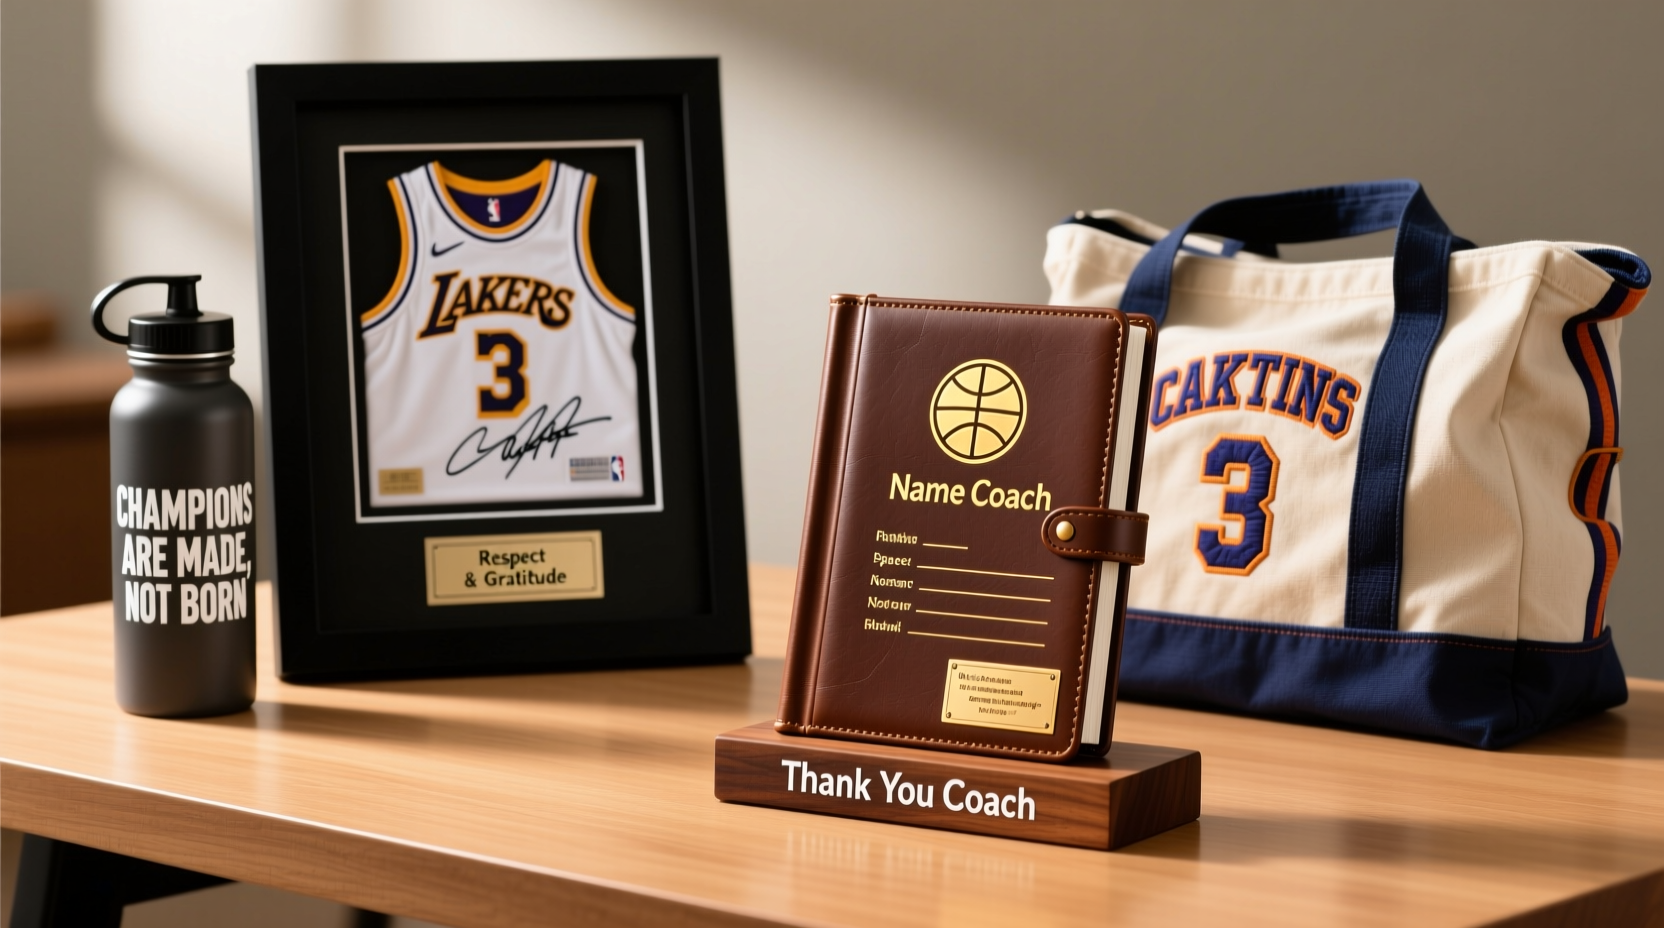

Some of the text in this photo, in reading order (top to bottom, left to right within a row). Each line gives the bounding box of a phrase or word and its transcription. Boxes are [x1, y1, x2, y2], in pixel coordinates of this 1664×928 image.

[416, 270, 575, 341] LAKERS
[474, 328, 531, 419] 3
[1150, 350, 1362, 440] CAKTINS
[116, 481, 253, 531] CHAMPIONS
[889, 472, 1052, 511] Name Coach
[1193, 432, 1281, 577] 3
[121, 531, 252, 579] ARE MADE,
[464, 567, 567, 588] & Gratitude
[479, 548, 546, 569] Respect
[125, 577, 247, 625] NOT BORN
[781, 759, 1035, 821] Thank You Coach
